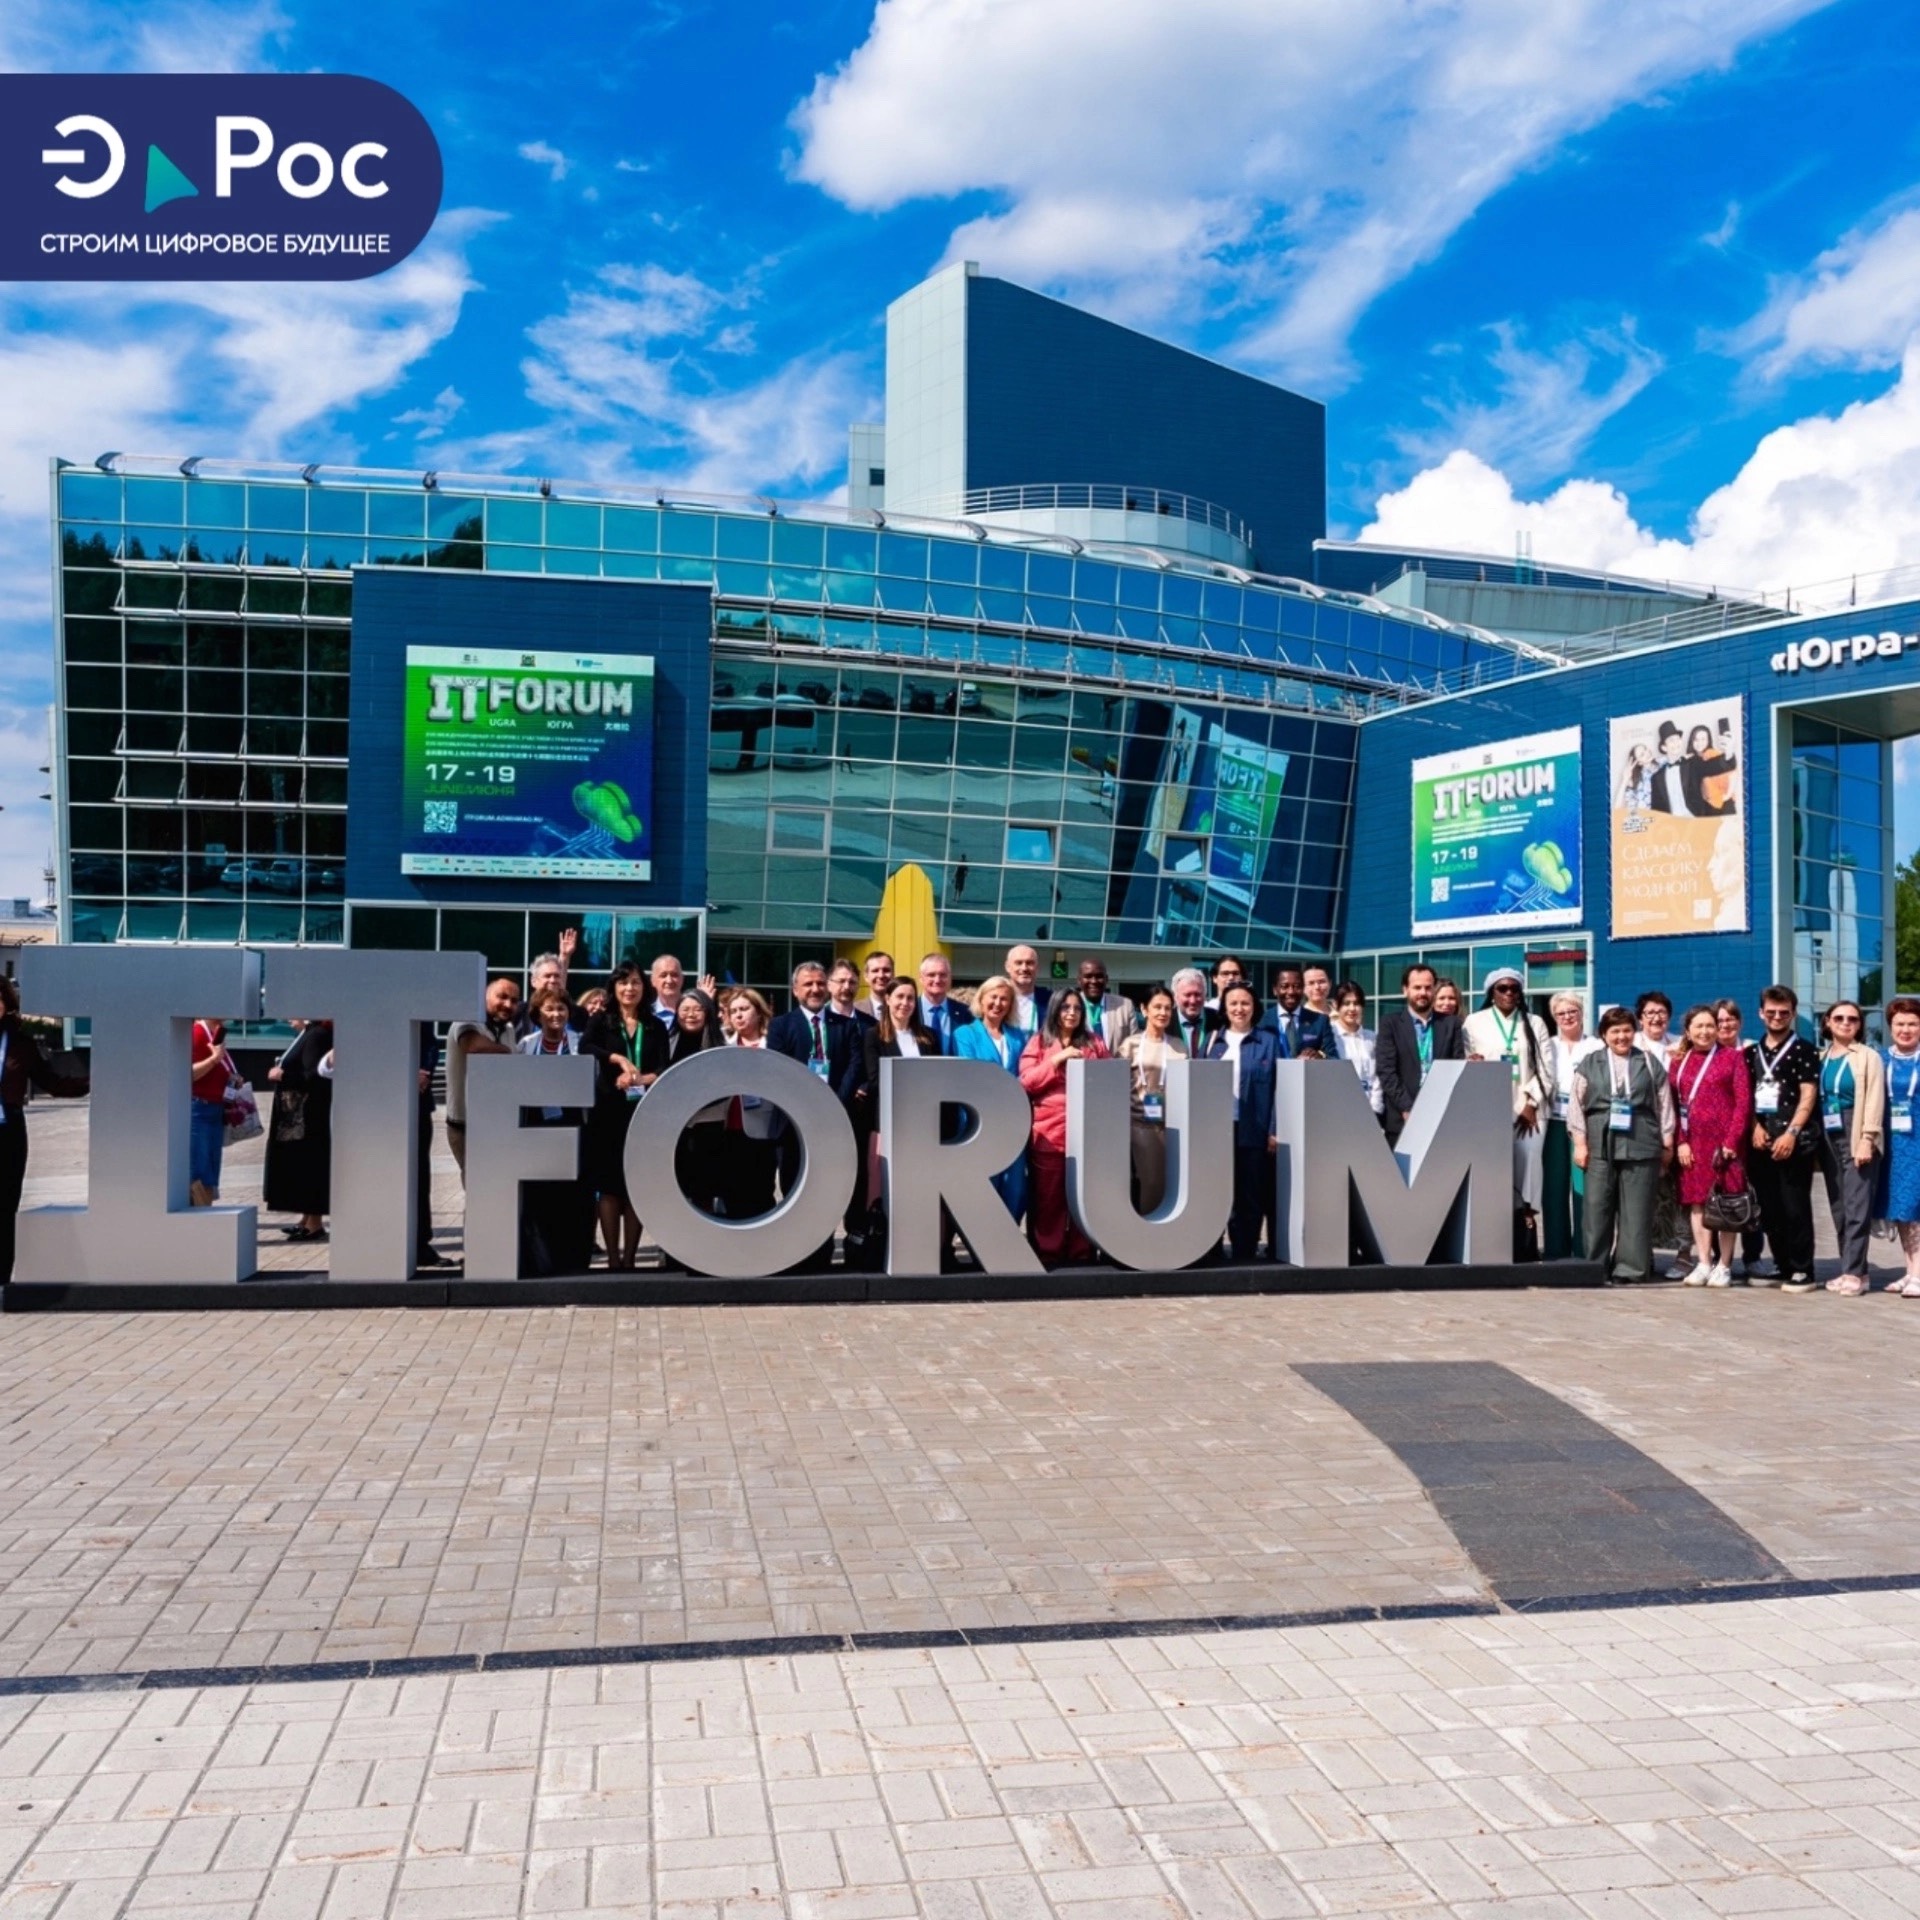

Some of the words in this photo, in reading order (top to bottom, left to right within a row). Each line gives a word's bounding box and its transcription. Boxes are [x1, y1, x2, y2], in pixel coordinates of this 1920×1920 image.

[489, 718, 517, 728] UGRA
[547, 720, 574, 730] ЮГРА
[425, 763, 459, 781] 17
[483, 765, 516, 783] 19
[1432, 850, 1449, 864] 17
[1460, 846, 1478, 861] 19
